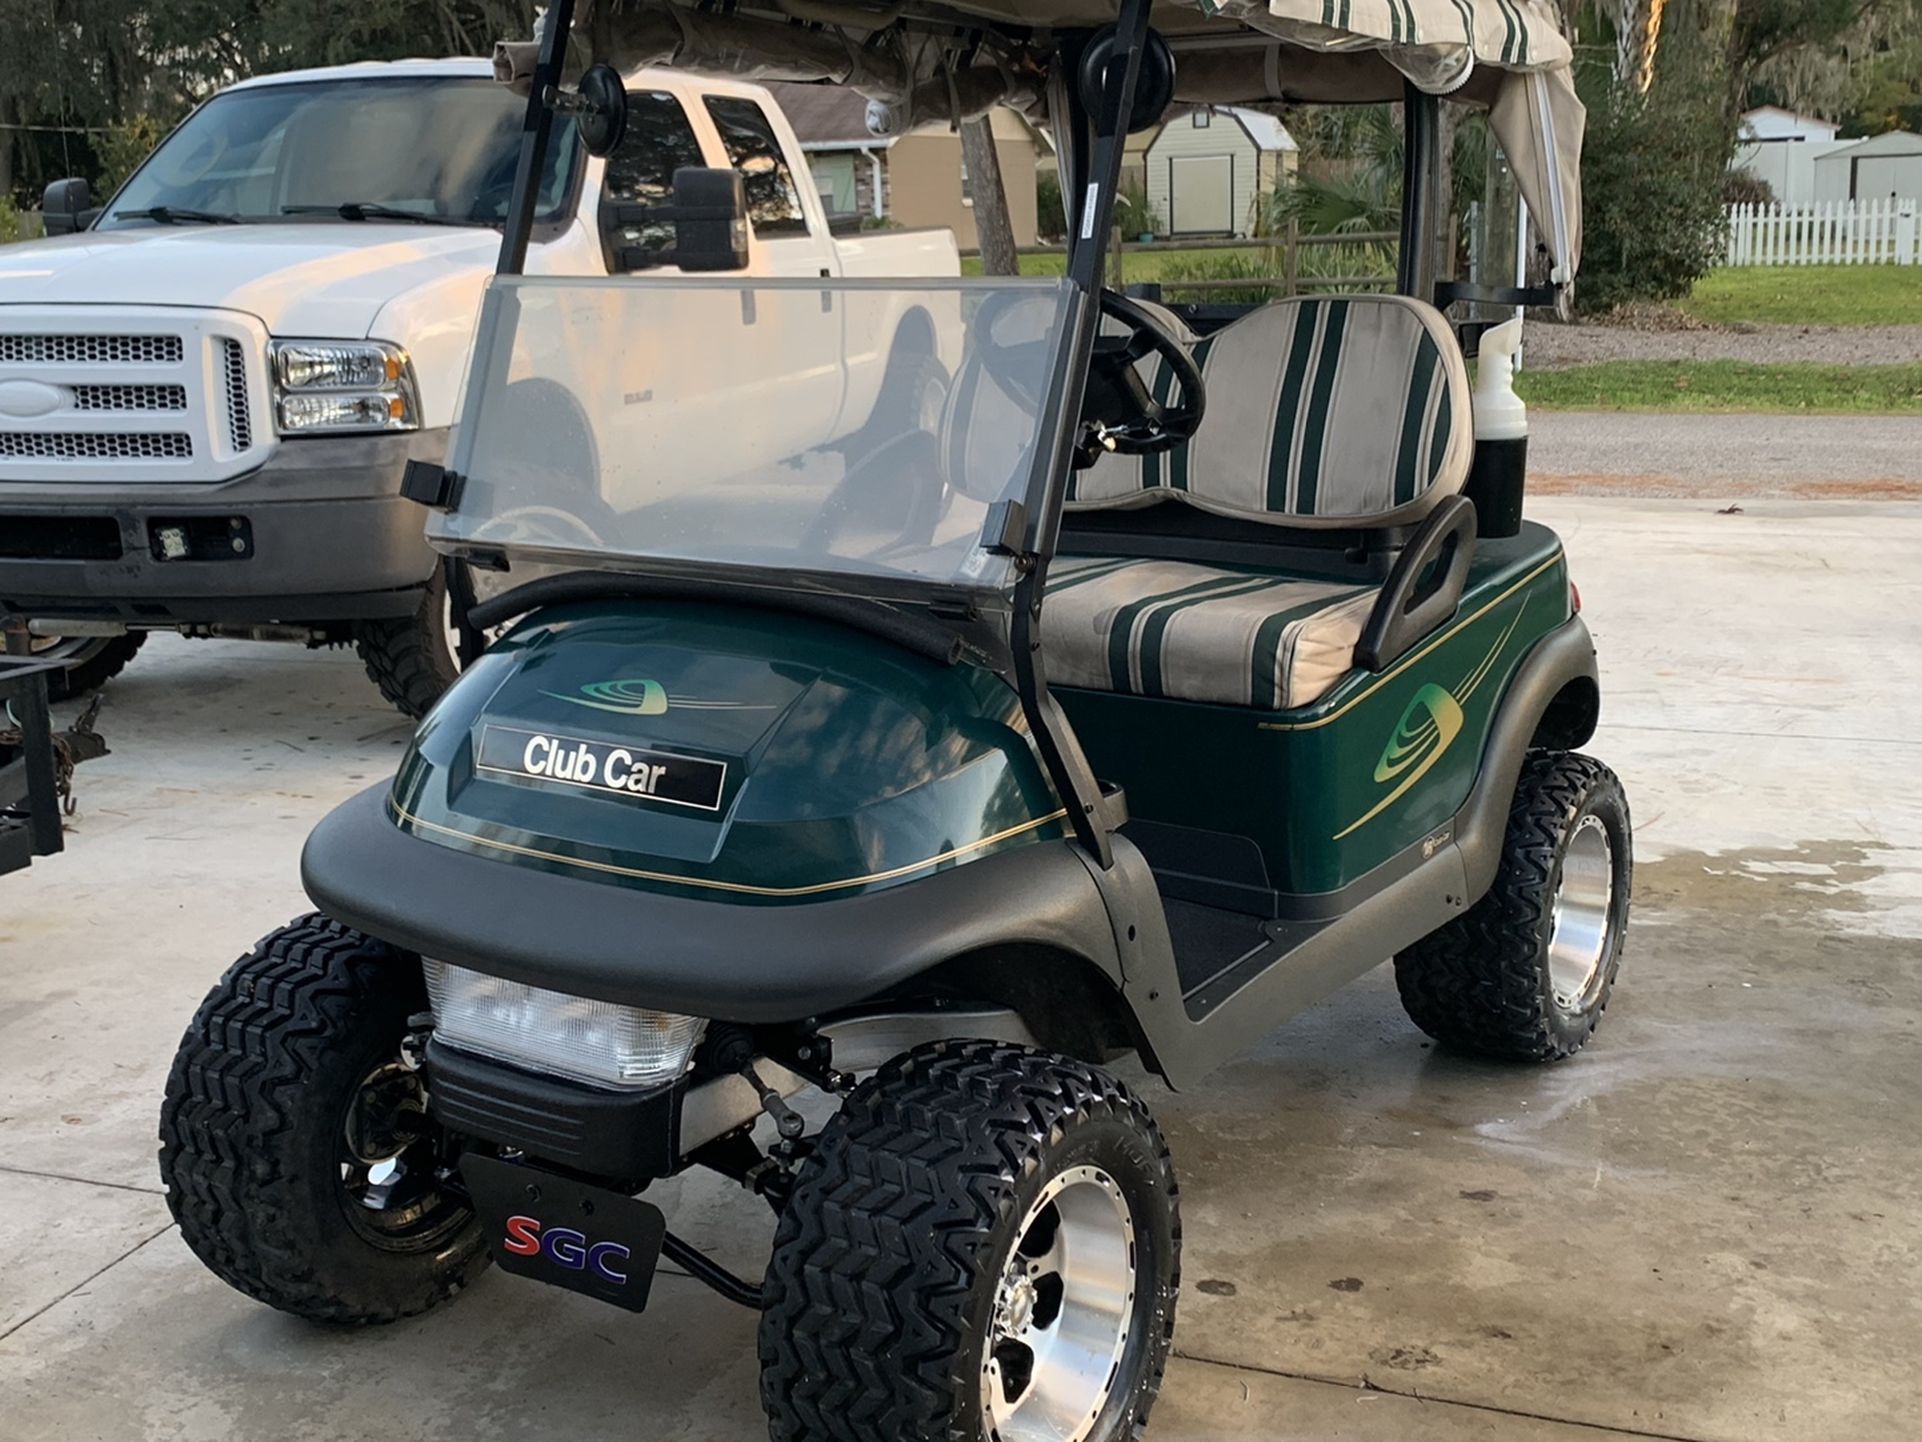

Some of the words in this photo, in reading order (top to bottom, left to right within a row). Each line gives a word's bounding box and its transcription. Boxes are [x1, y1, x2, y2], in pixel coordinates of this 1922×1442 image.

[523, 735, 597, 783] Club
[603, 749, 666, 794] Car
[504, 1215, 631, 1285] SGC
